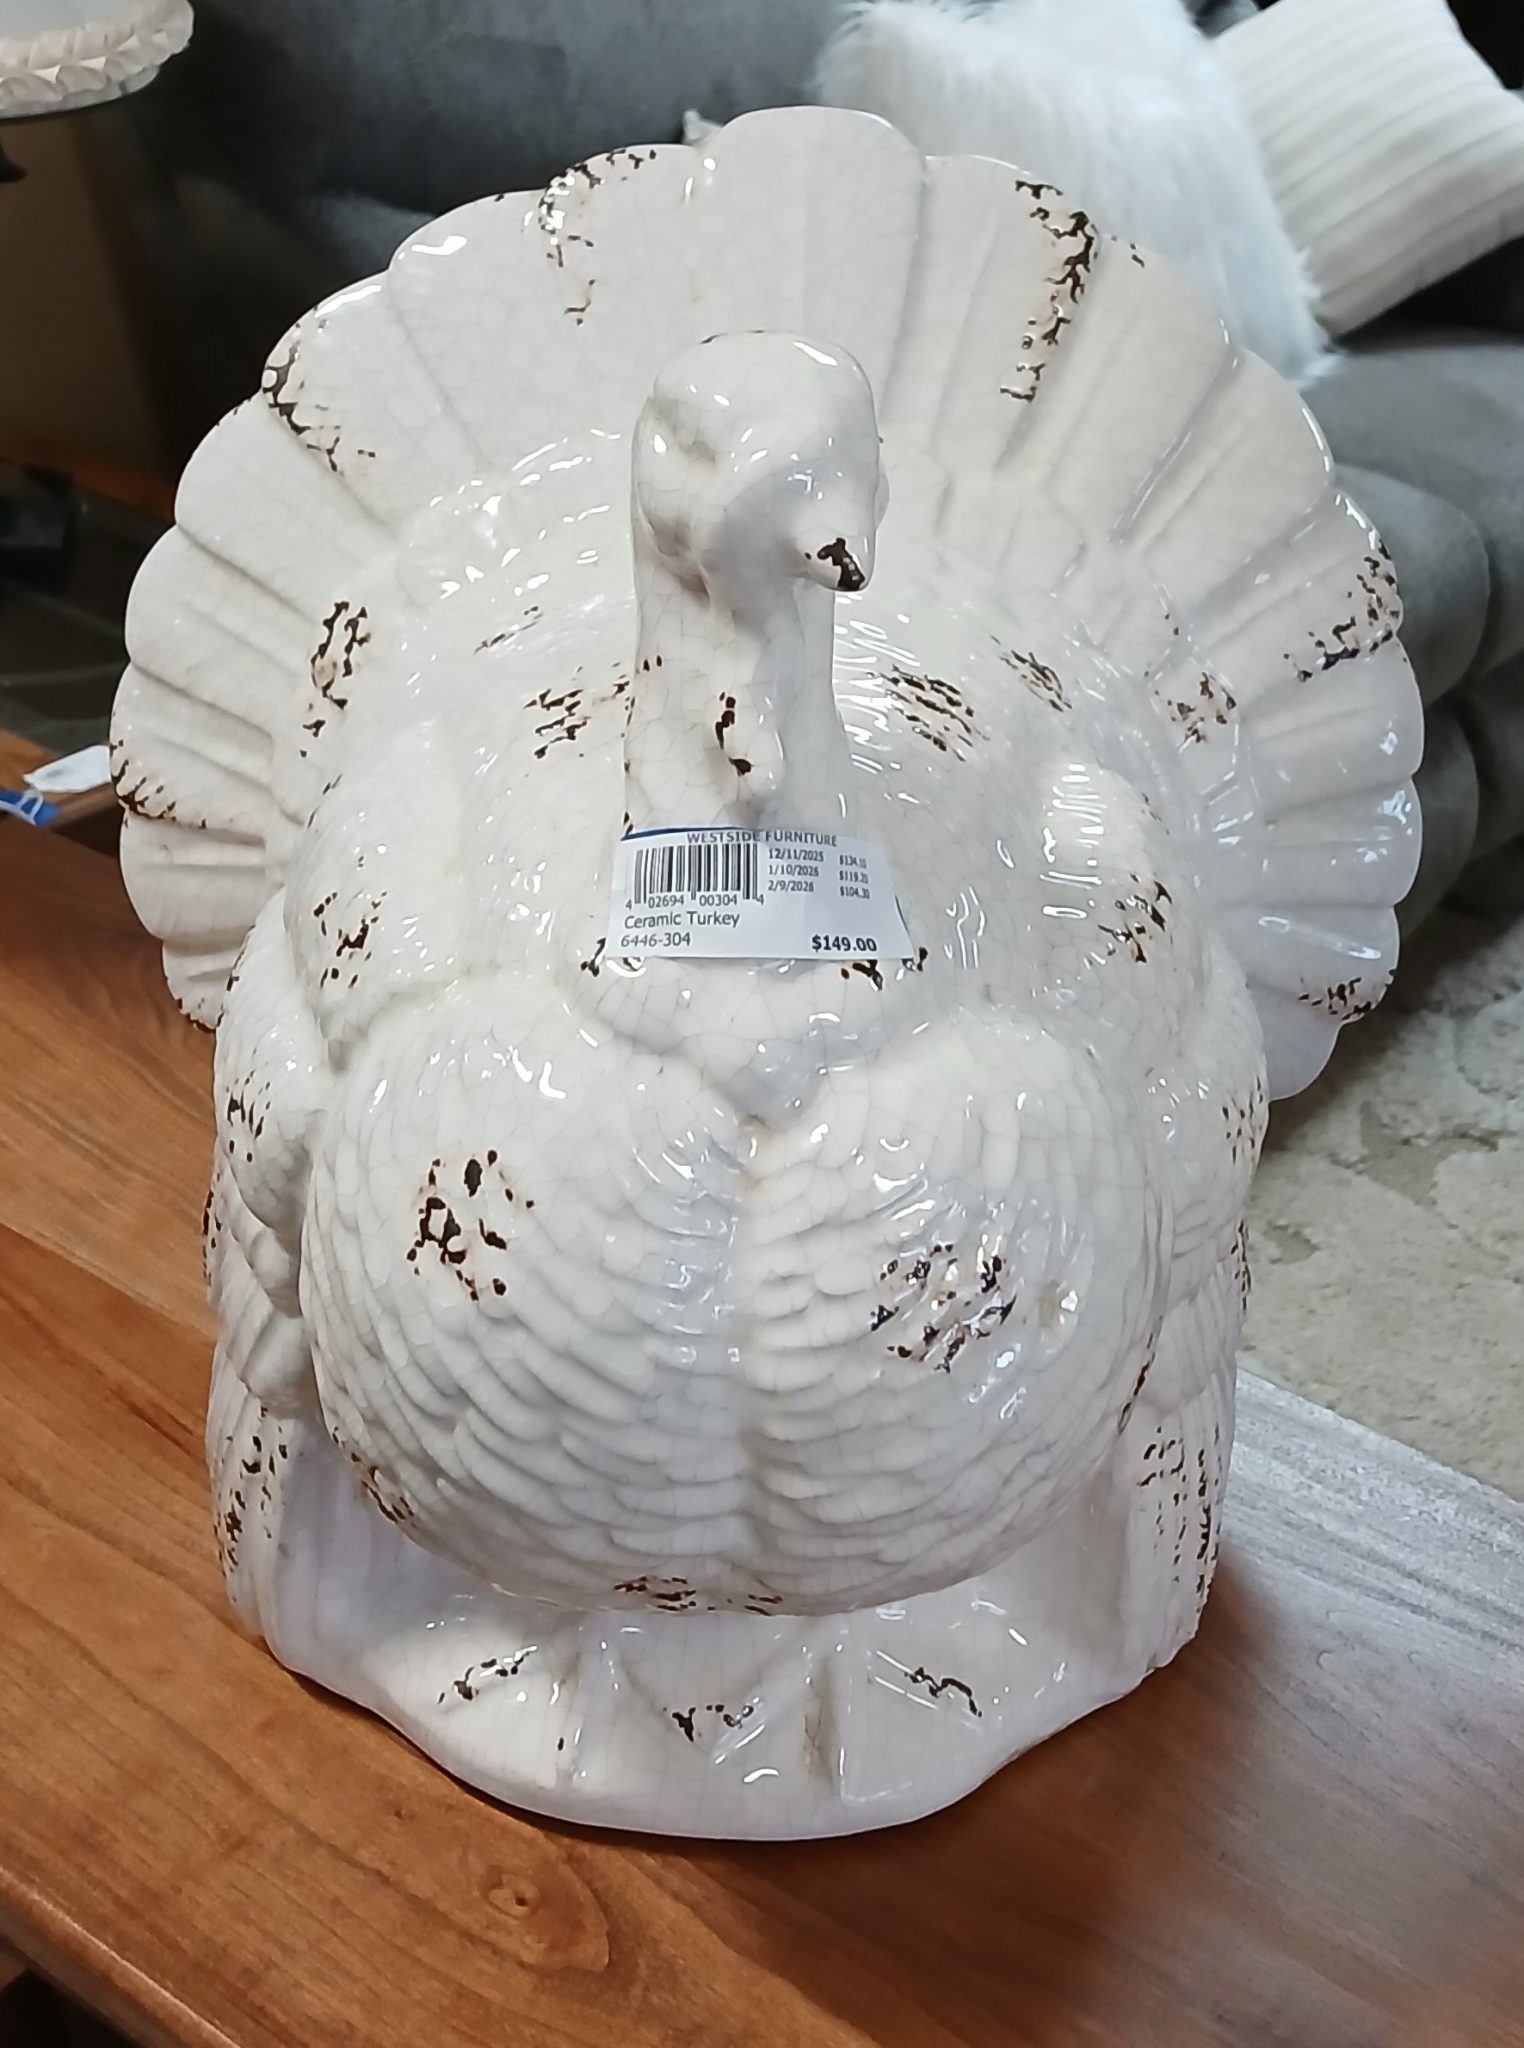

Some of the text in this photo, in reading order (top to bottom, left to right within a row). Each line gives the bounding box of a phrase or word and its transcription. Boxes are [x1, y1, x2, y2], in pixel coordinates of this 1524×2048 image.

[687, 830, 837, 847] WESTSIDE FURNITURE
[768, 850, 824, 862] 12/11/2025
[768, 881, 814, 893] 2/9/2026
[648, 895, 684, 909] 02694
[699, 895, 738, 907] 00304
[624, 911, 740, 930] Ceramic Turkey
[620, 932, 691, 947] 6446-304
[811, 934, 877, 953] $149.00
